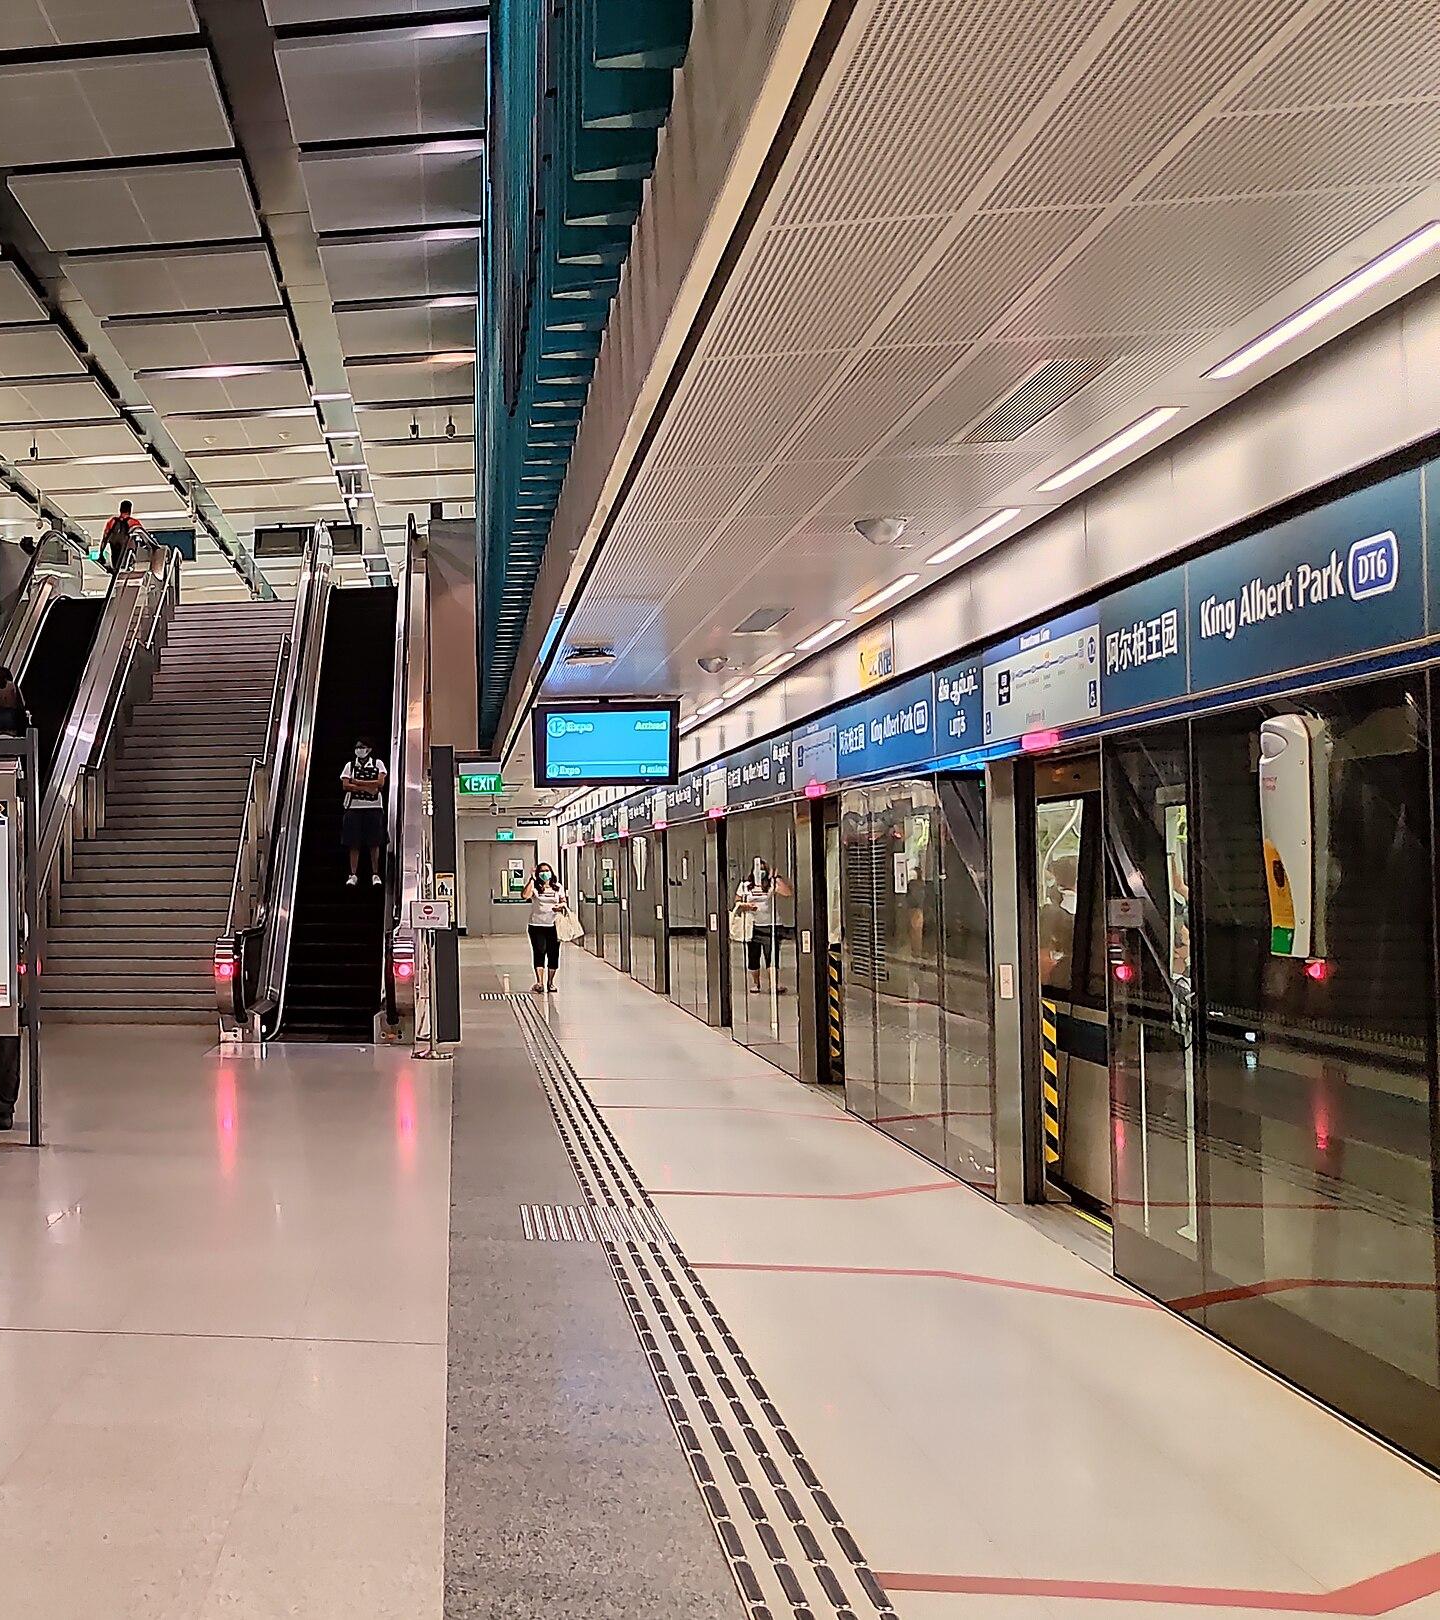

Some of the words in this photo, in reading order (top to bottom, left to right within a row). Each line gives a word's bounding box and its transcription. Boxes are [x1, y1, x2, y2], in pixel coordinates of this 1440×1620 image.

[1200, 594, 1236, 640] King
[1239, 571, 1294, 626] Albert
[1297, 550, 1344, 608] Park
[1357, 548, 1388, 585] DT6
[1106, 608, 1178, 676] 阿尔柏王园
[565, 722, 594, 734] Expo
[471, 777, 496, 791] EXIT
